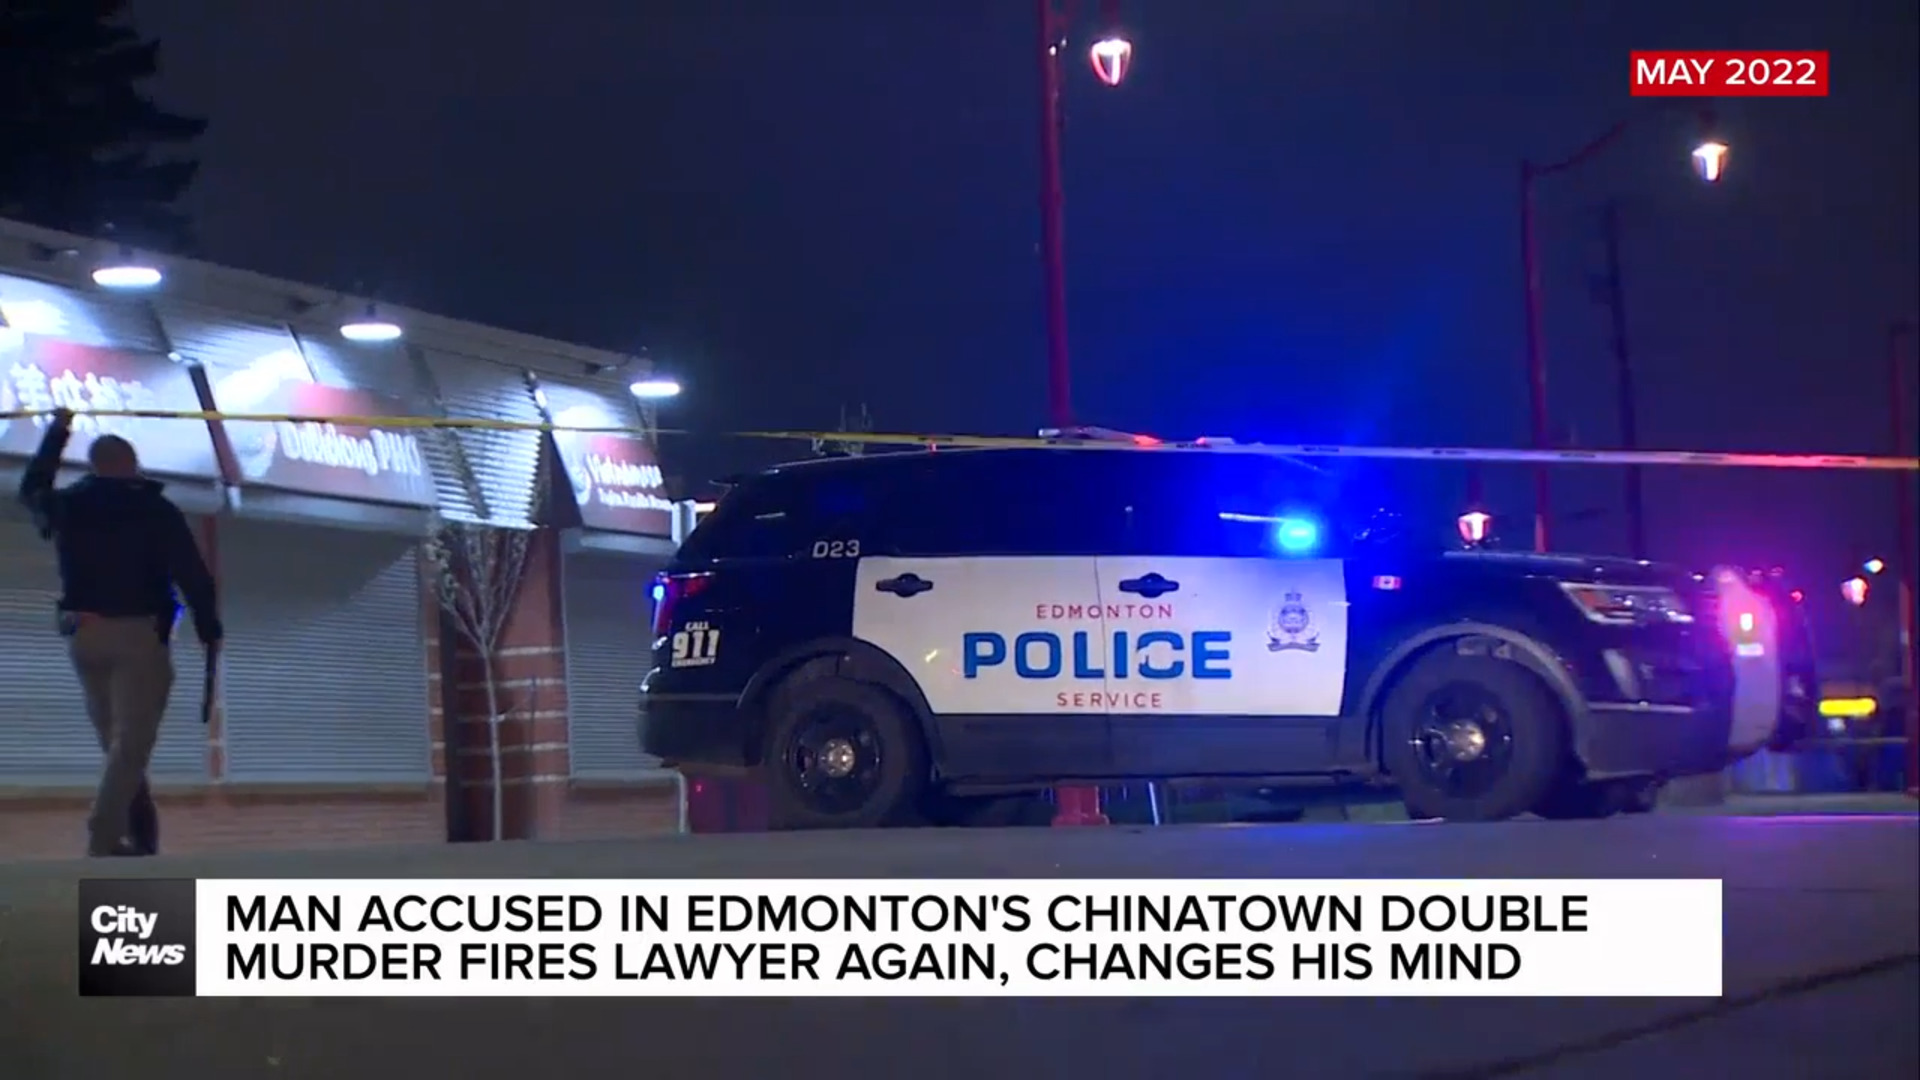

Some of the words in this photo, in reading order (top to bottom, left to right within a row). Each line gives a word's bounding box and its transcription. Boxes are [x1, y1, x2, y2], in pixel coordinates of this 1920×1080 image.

[370, 428, 422, 476] PHO
[812, 540, 860, 558] D23
[1035, 603, 1174, 620] EDMONTON
[685, 621, 709, 632] CALL
[672, 630, 720, 659] 911
[962, 631, 1233, 679] POLICE
[1056, 692, 1163, 708] SERVICE
